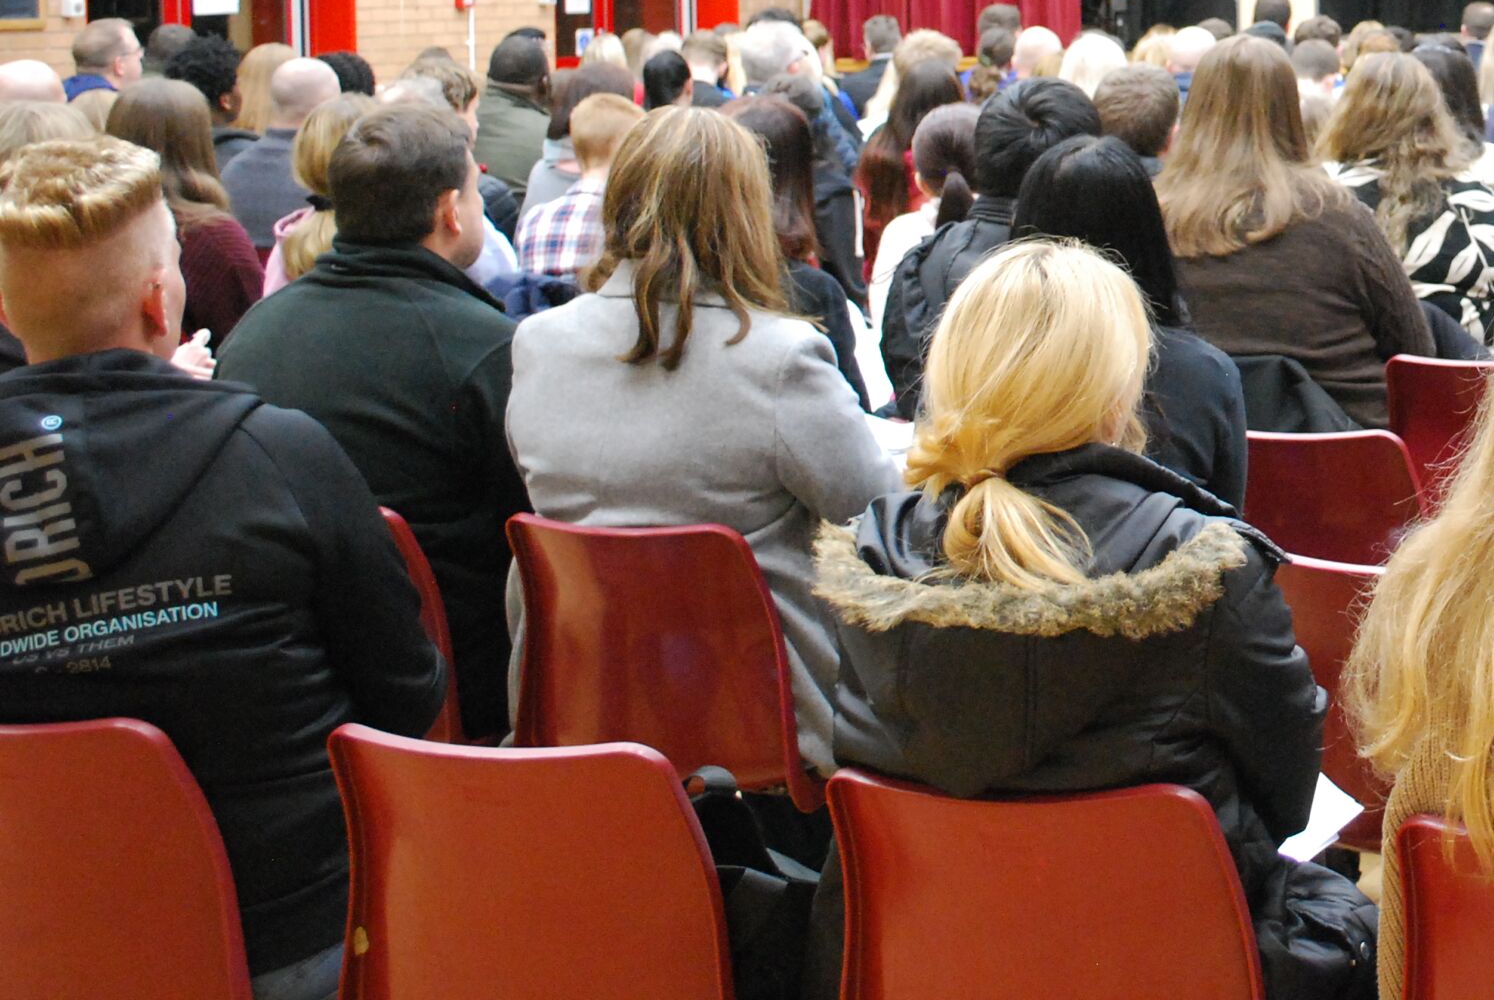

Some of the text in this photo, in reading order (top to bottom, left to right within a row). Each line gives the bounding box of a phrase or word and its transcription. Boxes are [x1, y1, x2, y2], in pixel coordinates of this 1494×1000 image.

[73, 574, 233, 619] LIFESTYLE
[63, 600, 219, 643] ORGANISATION
[78, 634, 136, 655] THEM
